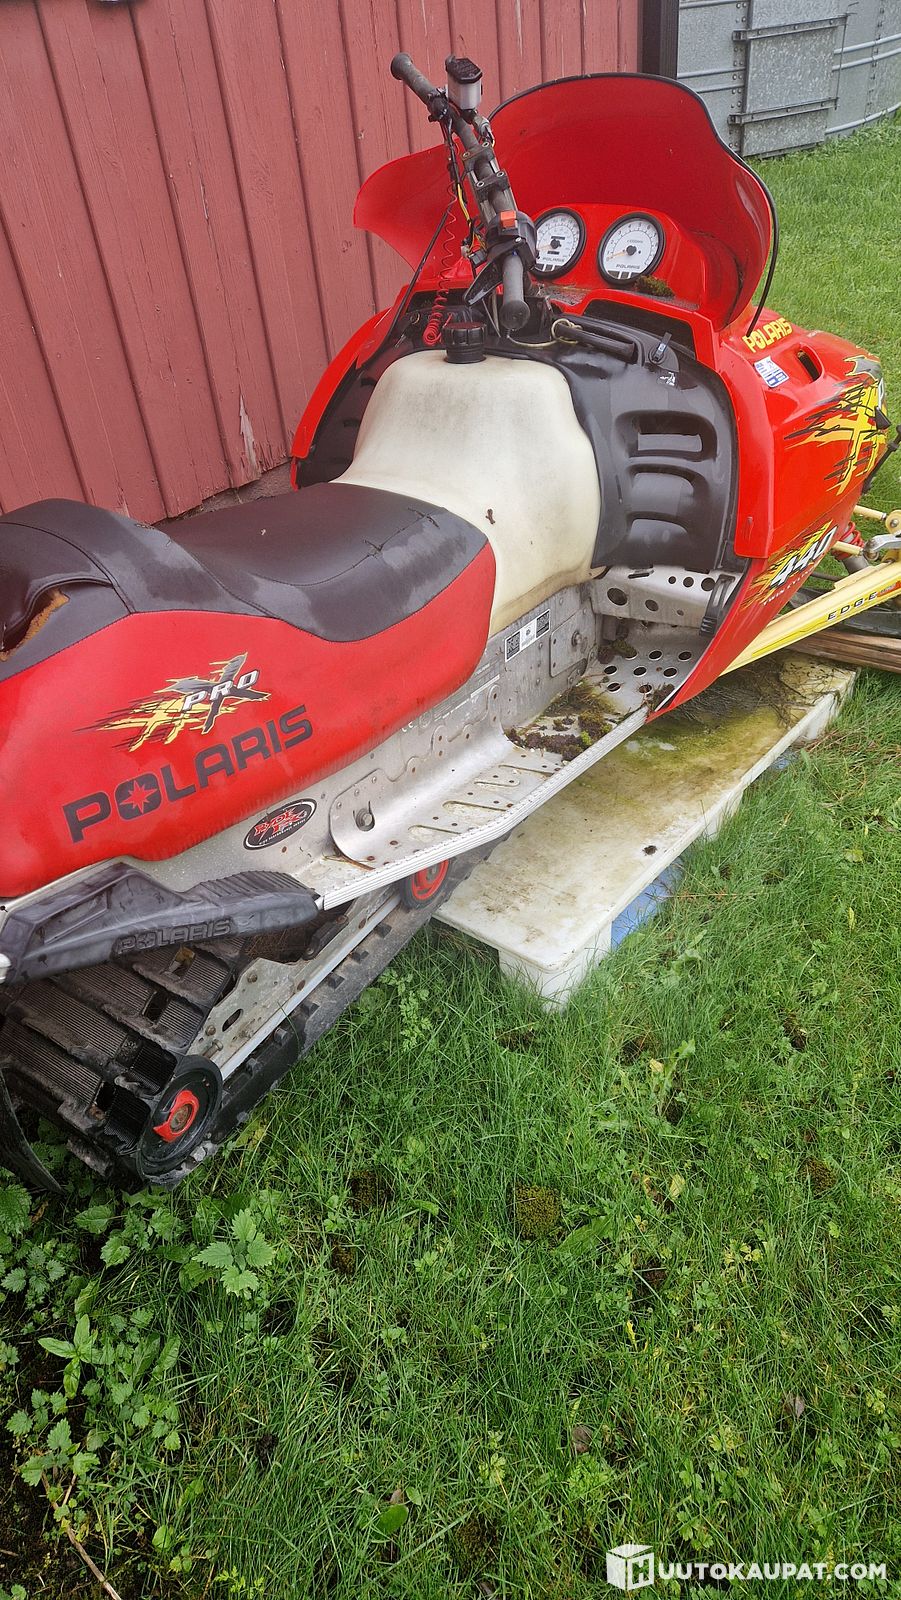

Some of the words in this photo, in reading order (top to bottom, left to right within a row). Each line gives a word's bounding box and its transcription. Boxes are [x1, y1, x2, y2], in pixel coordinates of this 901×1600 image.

[741, 317, 793, 353] POLARIS
[769, 526, 838, 590] 440
[827, 591, 878, 621] EDGE
[182, 669, 260, 712] PRO
[62, 704, 313, 844] POLARIS
[117, 918, 232, 955] POLARIS
